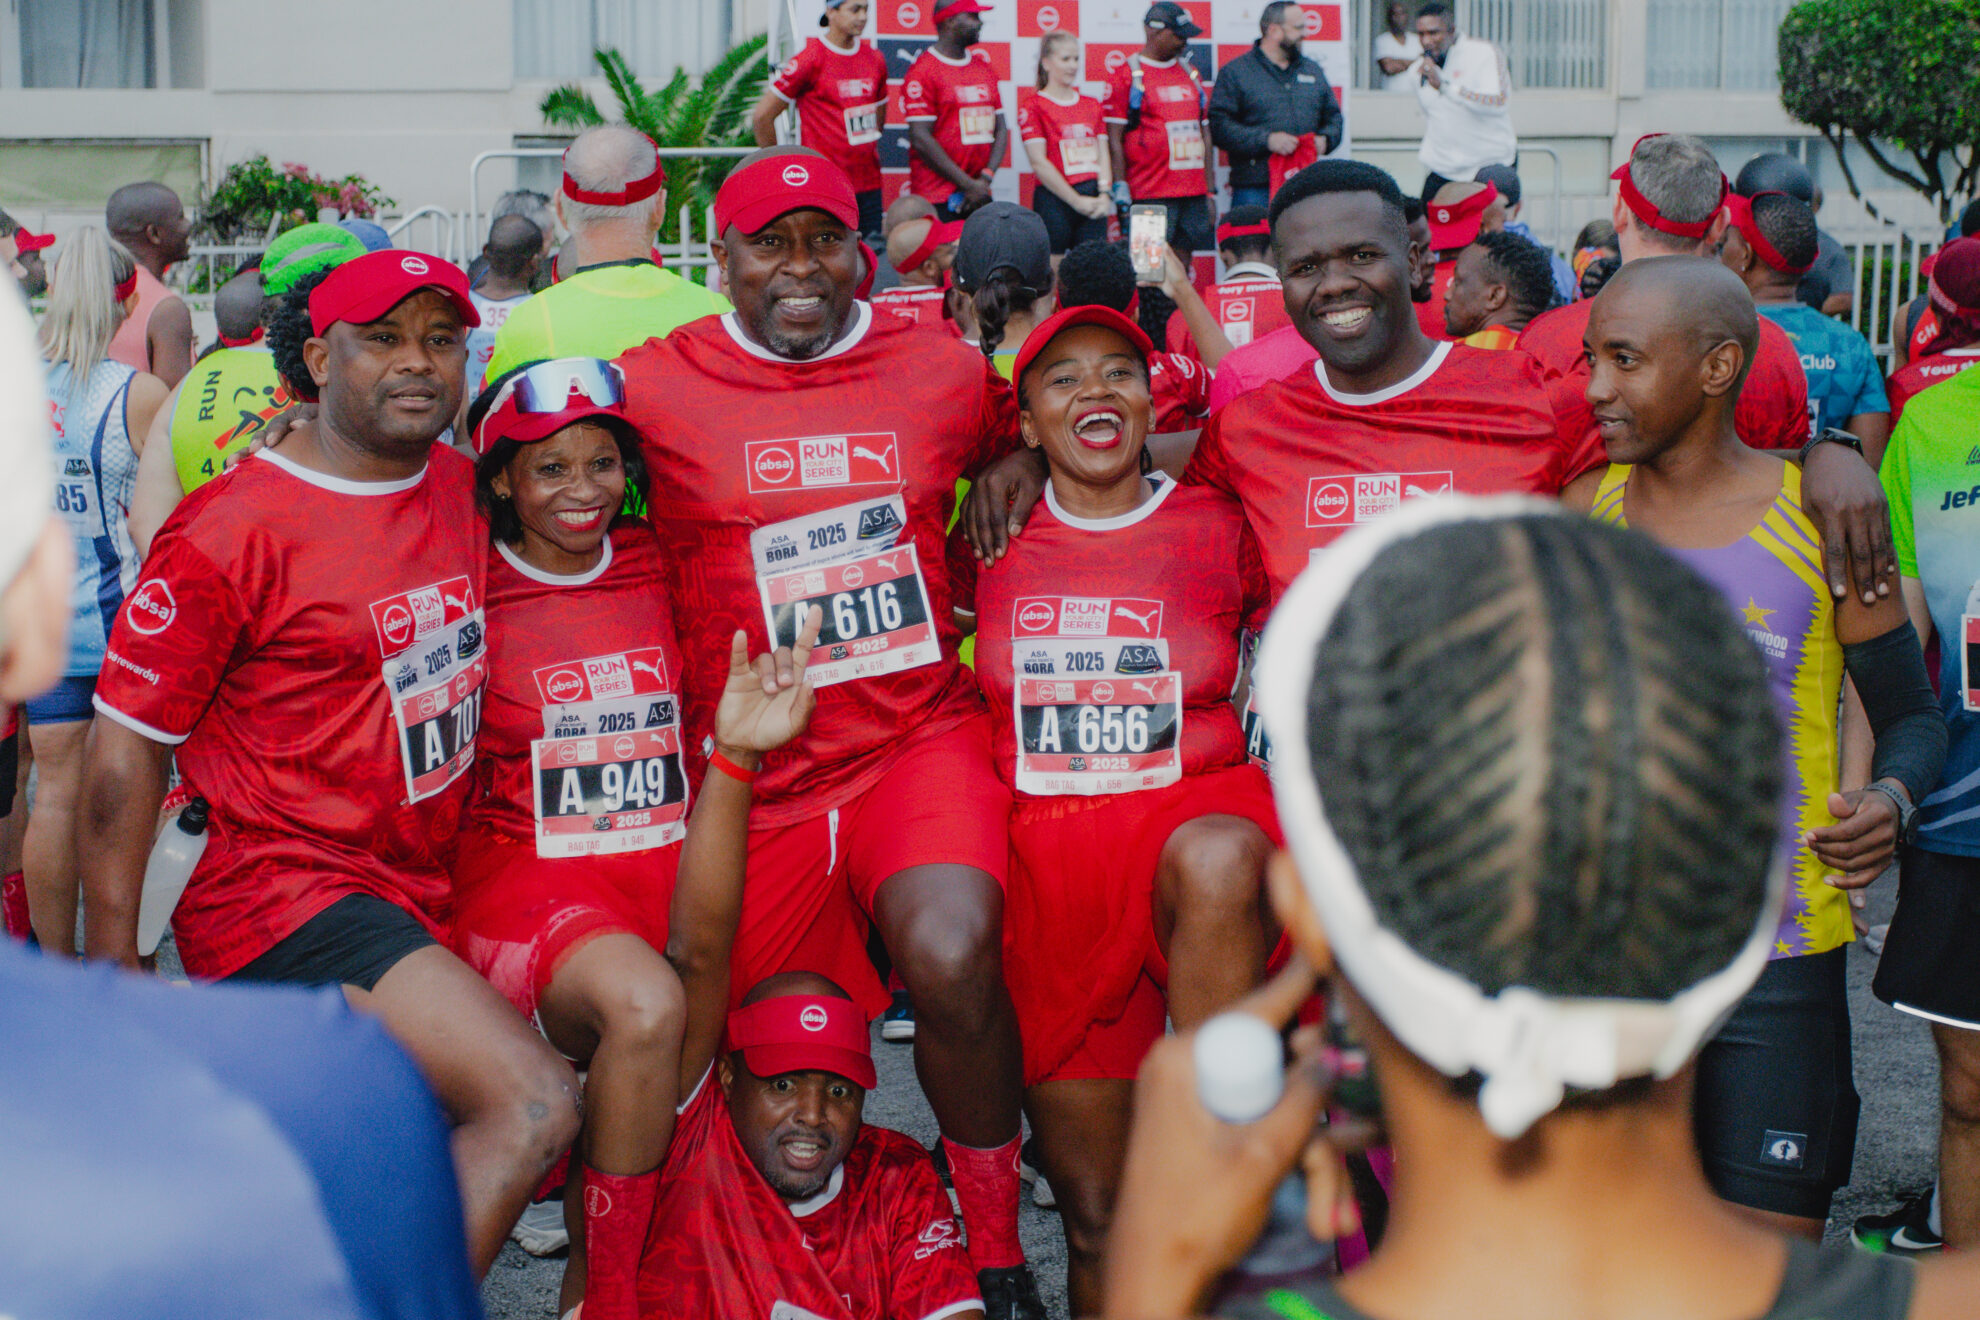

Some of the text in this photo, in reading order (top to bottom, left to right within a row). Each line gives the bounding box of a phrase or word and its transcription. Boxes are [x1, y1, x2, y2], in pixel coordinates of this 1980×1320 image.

[1801, 353, 1836, 370] Club
[1920, 364, 1957, 377] Your
[198, 370, 222, 422] RUN
[803, 442, 844, 461] RUN
[201, 458, 214, 476] 4
[759, 458, 789, 471] absa
[805, 467, 843, 479] SERIES
[1358, 480, 1397, 497] RUN
[1318, 494, 1345, 506] absa
[861, 507, 896, 528] ASA
[771, 535, 790, 545] ASA
[807, 522, 847, 550] 2025
[766, 545, 799, 563] BORA
[412, 592, 440, 614] RUN
[832, 582, 902, 640] 616
[1065, 602, 1107, 615] RUN
[386, 617, 408, 632] absa
[1023, 611, 1049, 621] absa
[418, 618, 441, 633] SERIES
[1063, 620, 1101, 630] SERIES
[852, 637, 889, 656] 2025
[1766, 647, 1786, 659] CLUB
[424, 643, 452, 676] 2025
[1065, 651, 1105, 672] 2025
[1121, 648, 1158, 663] ASA
[588, 659, 626, 678] RUN
[1024, 663, 1055, 674] BORA
[552, 679, 579, 693] absa
[594, 680, 627, 694] SERIES
[561, 704, 673, 734] ASA 2025 ASA
[425, 686, 481, 772] A 701
[1039, 705, 1149, 753] A 656
[1249, 716, 1263, 755] A
[1091, 757, 1130, 770] 2025
[559, 758, 665, 815] A 949
[616, 812, 651, 828] 2025
[586, 840, 600, 850] TAG
